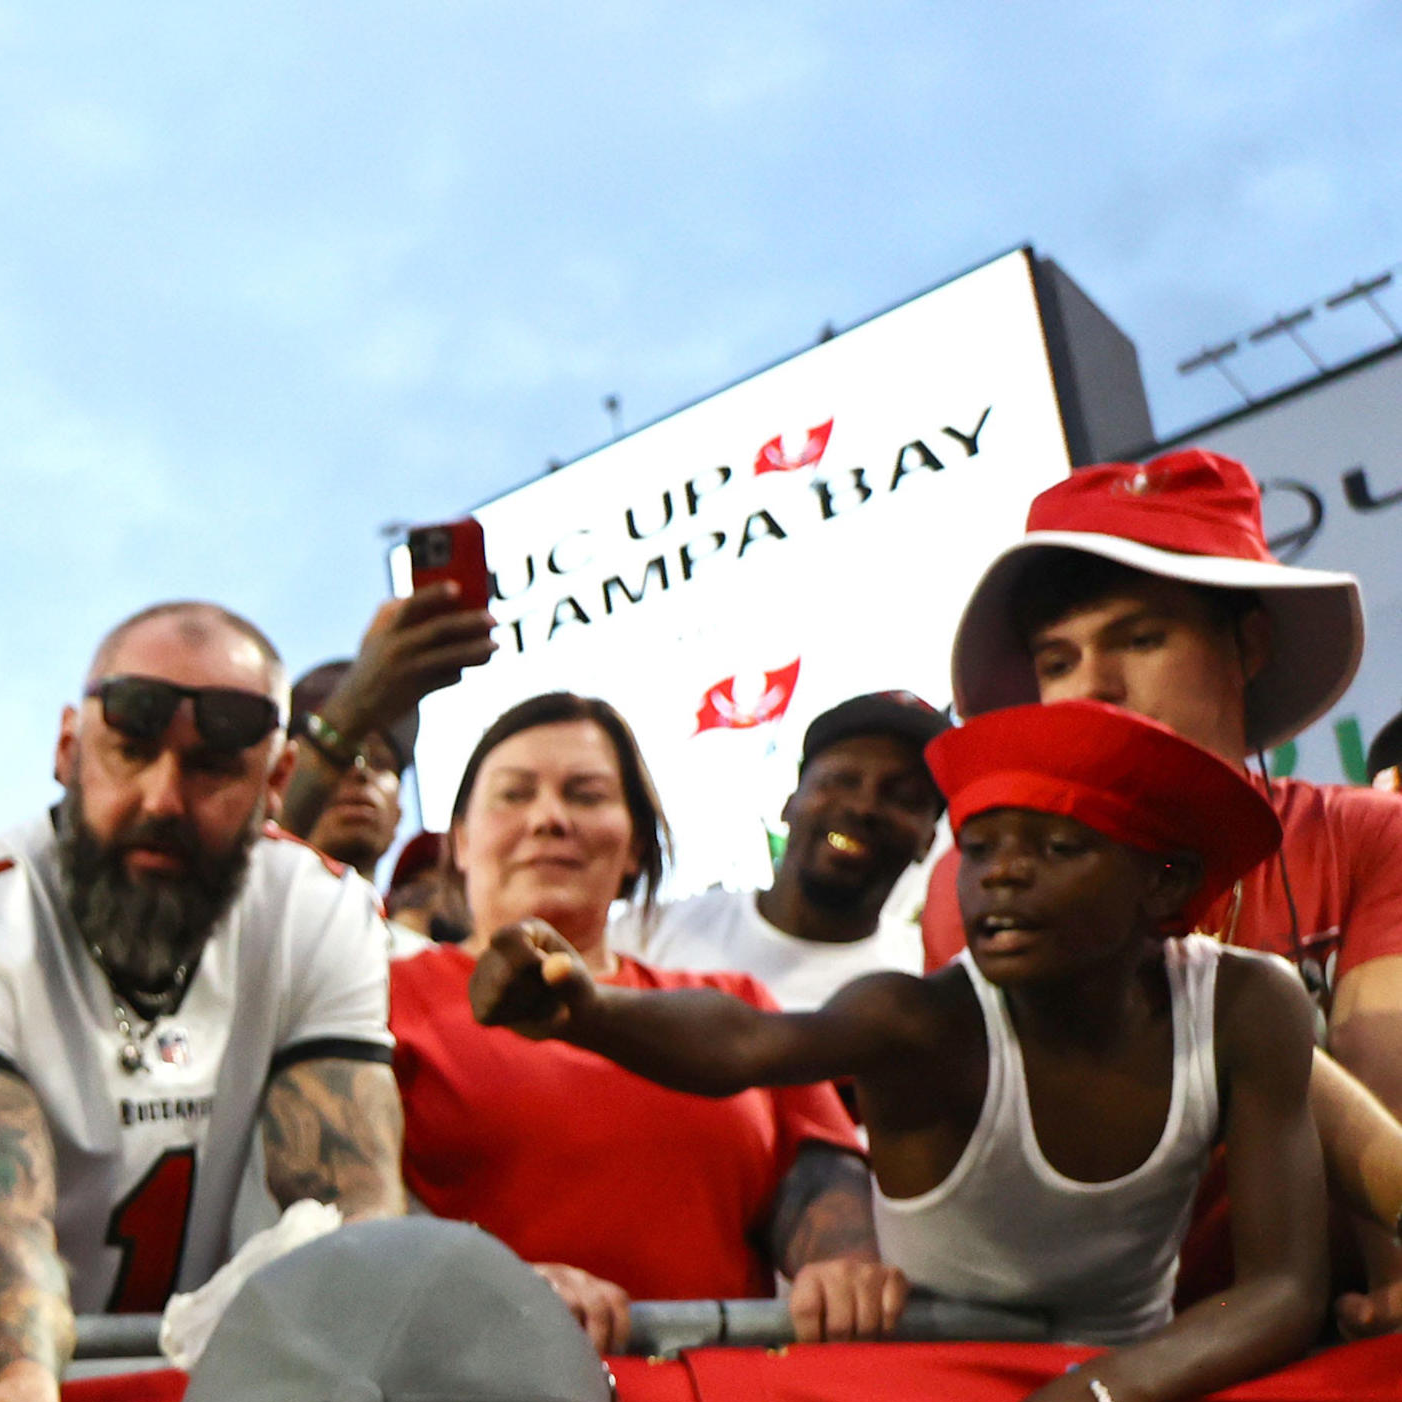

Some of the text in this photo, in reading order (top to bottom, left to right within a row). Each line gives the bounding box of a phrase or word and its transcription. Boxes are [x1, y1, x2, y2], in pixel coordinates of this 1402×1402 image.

[492, 466, 732, 600] UC UP
[499, 405, 992, 654] TAMPA BAY
[104, 1145, 198, 1314] 1
